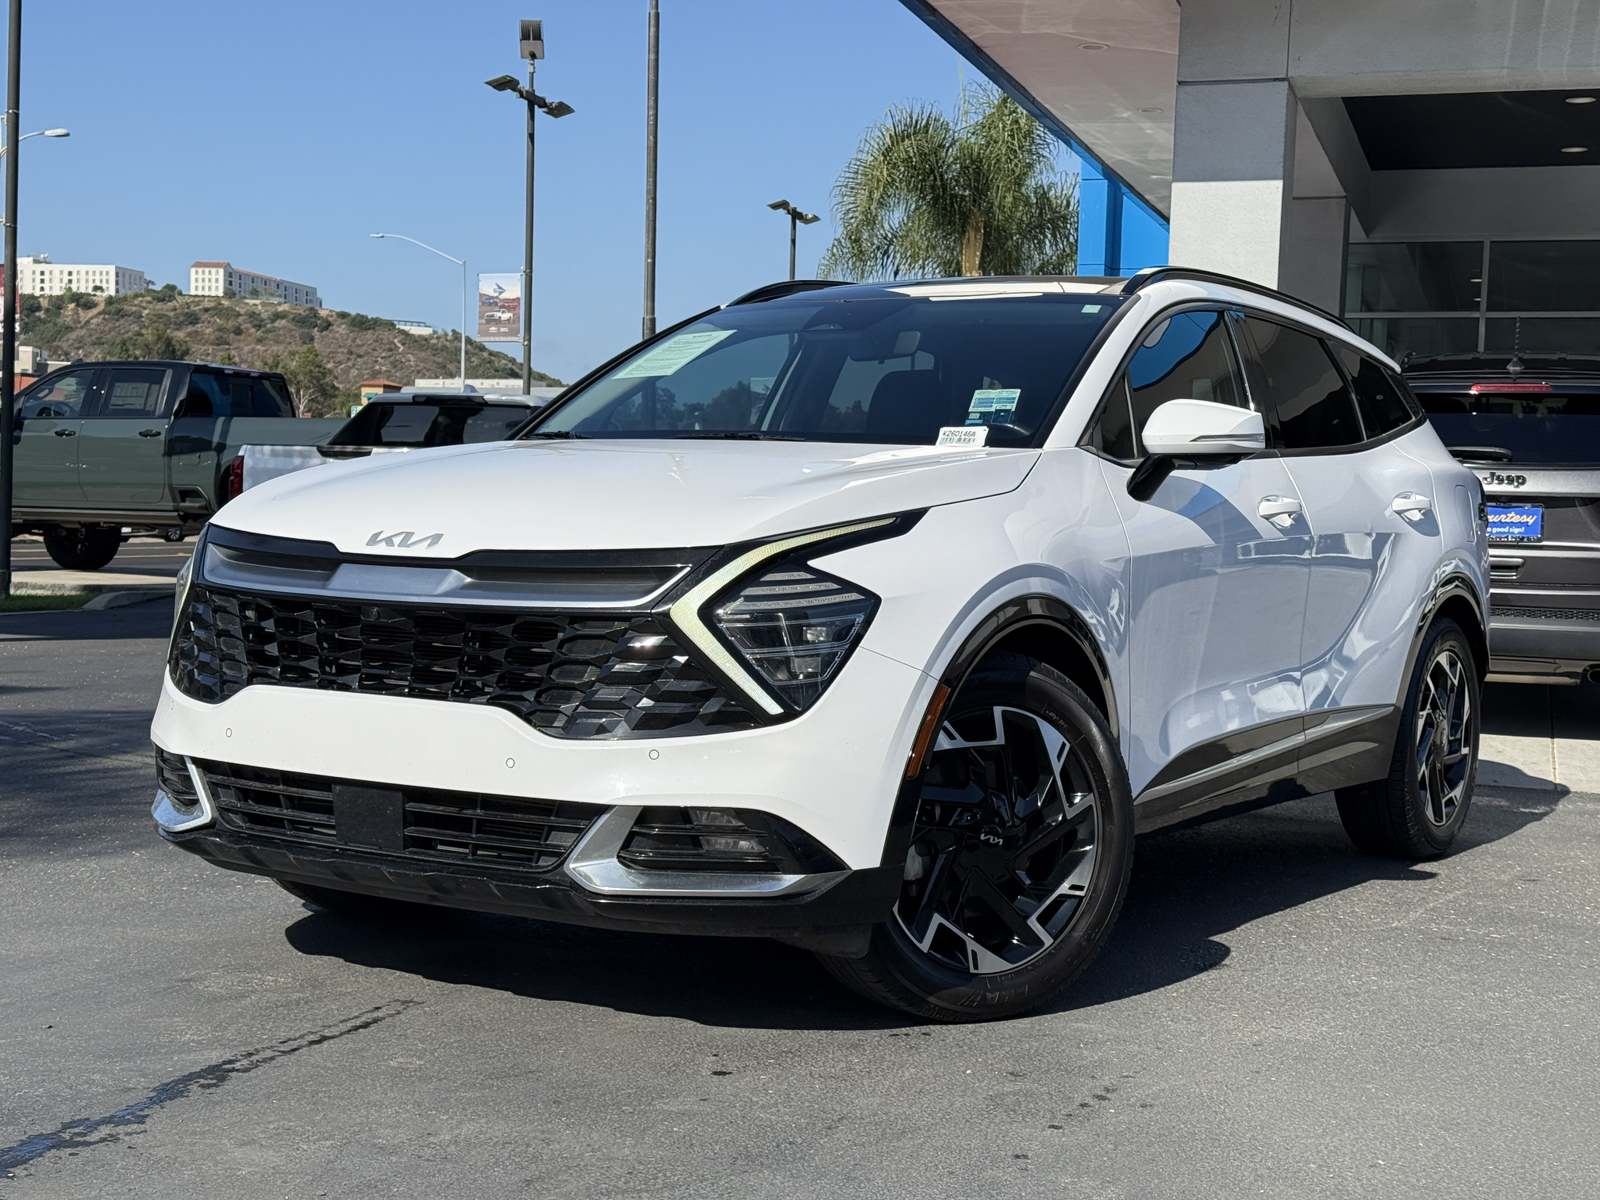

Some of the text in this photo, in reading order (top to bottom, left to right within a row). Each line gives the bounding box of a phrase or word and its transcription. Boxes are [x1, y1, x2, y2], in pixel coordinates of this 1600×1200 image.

[1482, 472, 1526, 488] Jeep
[1492, 526, 1509, 534] good
[365, 530, 445, 549] KIA
